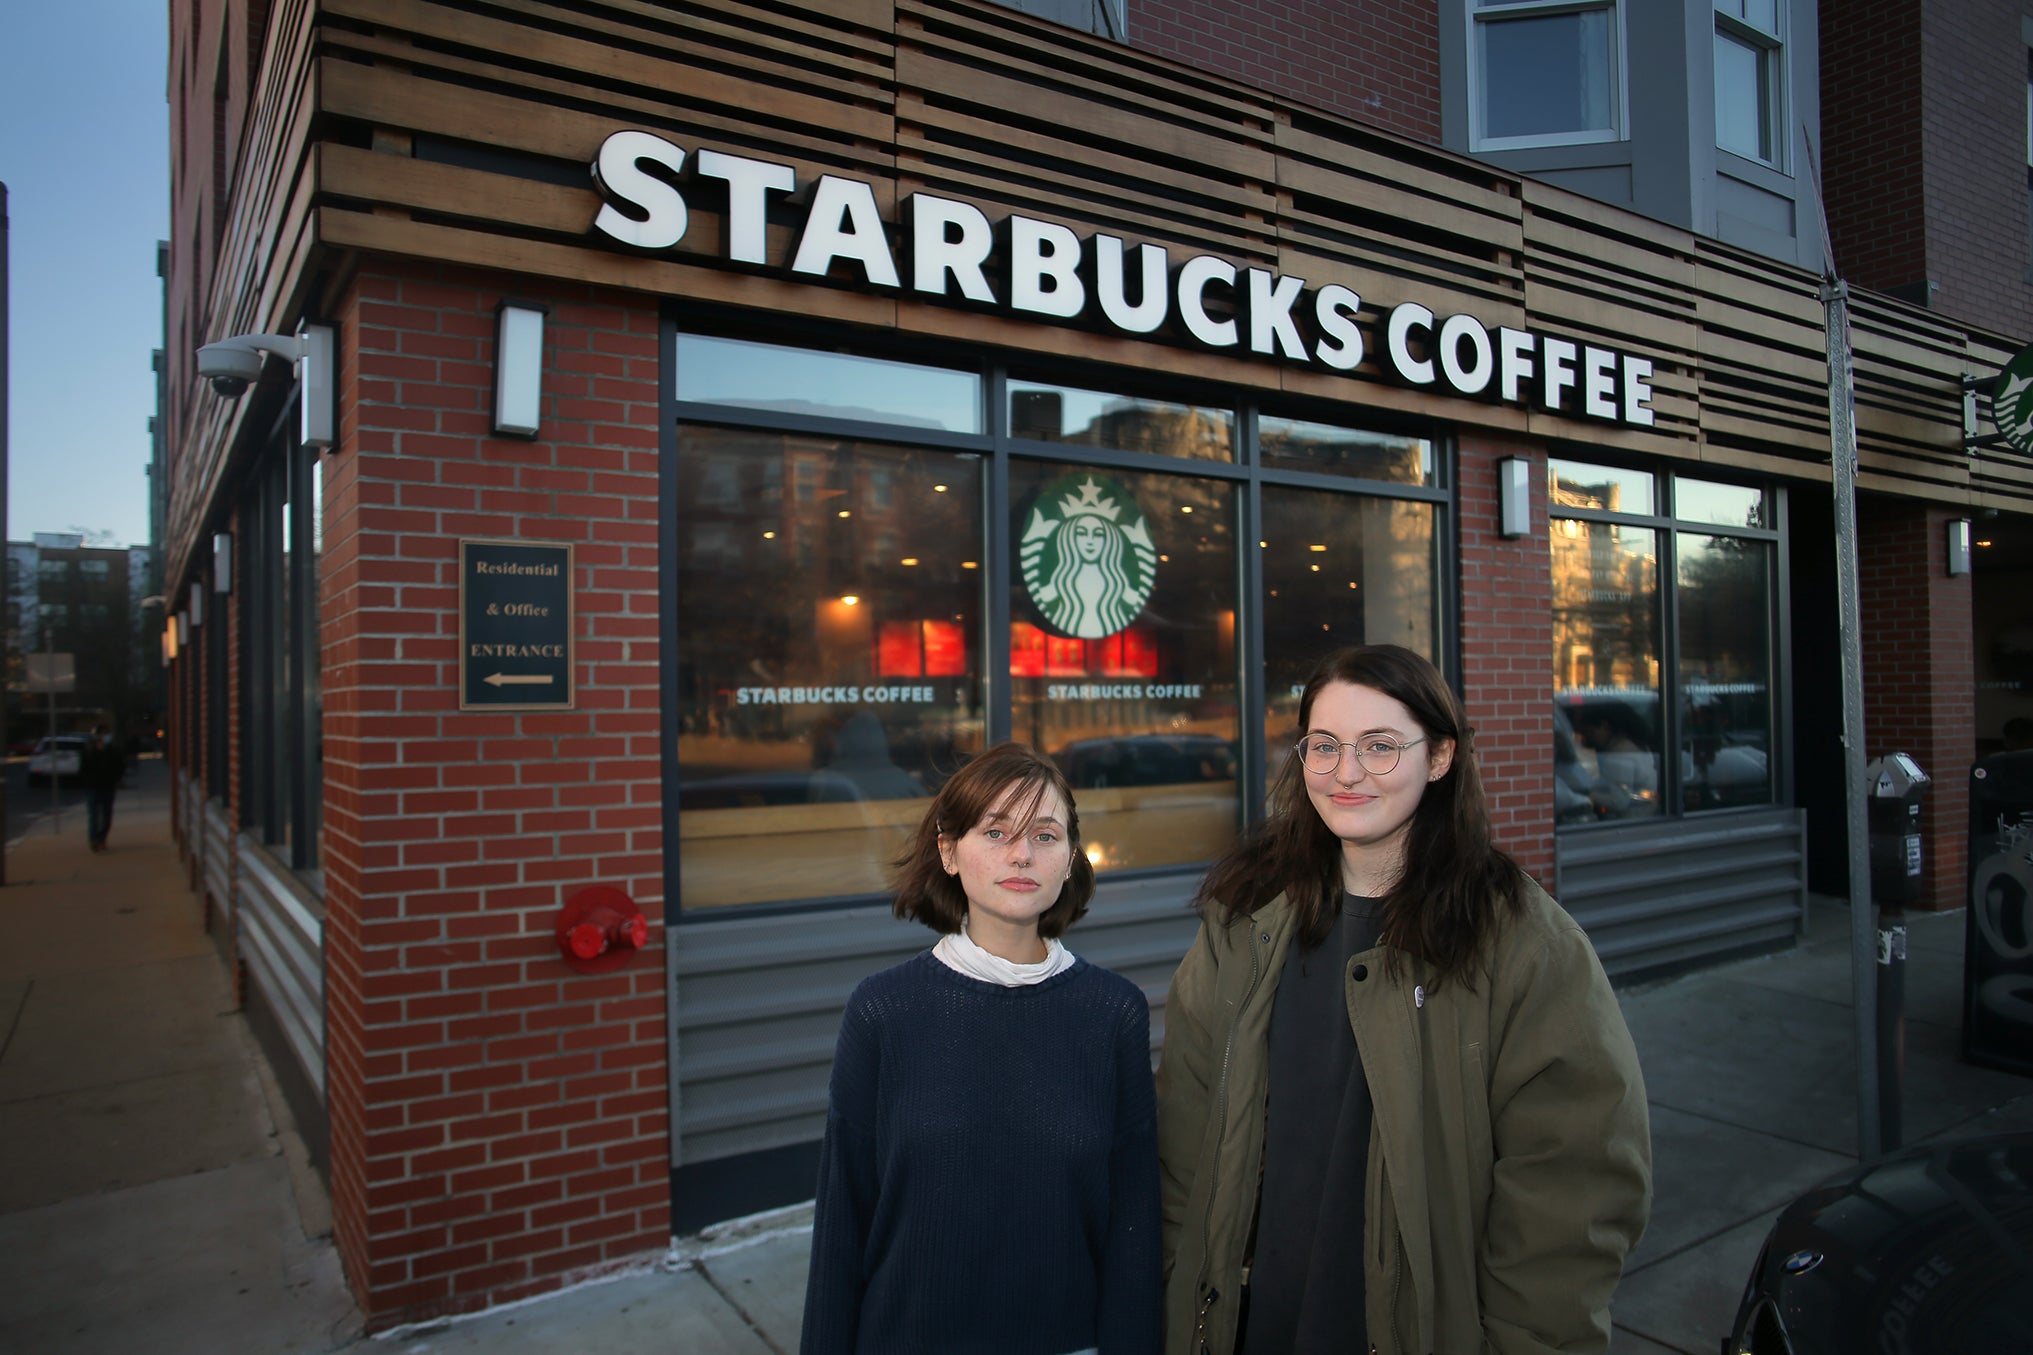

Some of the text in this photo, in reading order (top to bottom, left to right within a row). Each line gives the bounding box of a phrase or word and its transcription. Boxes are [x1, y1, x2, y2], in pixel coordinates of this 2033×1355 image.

[592, 128, 1655, 427] STARBUCKS COFFEE
[476, 562, 558, 576] Residential
[486, 603, 549, 617] & Office
[471, 645, 563, 657] ENTRANCE
[736, 686, 935, 704] STARBUCKS COFFEE
[1048, 684, 1201, 699] STARBUCKS COFFEE
[1686, 682, 1755, 695] STARBUCKS COFFEE
